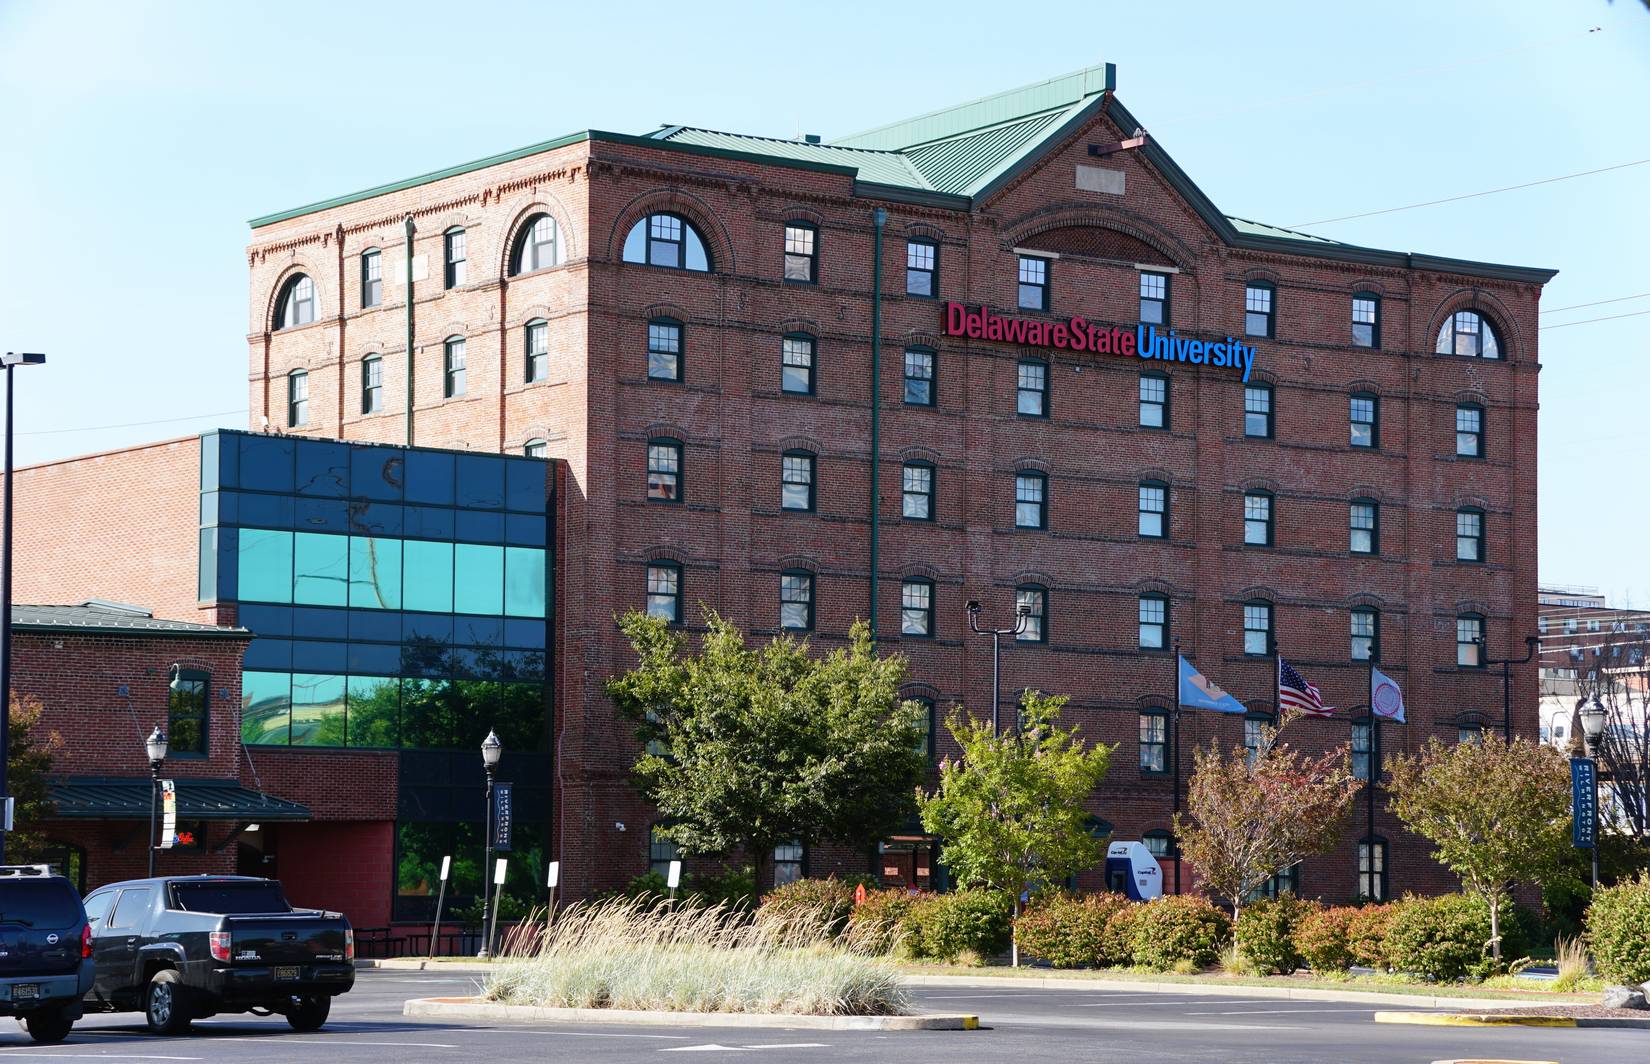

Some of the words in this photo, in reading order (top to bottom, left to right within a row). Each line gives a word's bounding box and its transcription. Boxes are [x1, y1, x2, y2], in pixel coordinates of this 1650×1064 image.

[947, 302, 1067, 348] Delaware
[1070, 316, 1136, 356] State
[1137, 324, 1257, 383] University
[1583, 765, 1593, 841] RIVERFRONT
